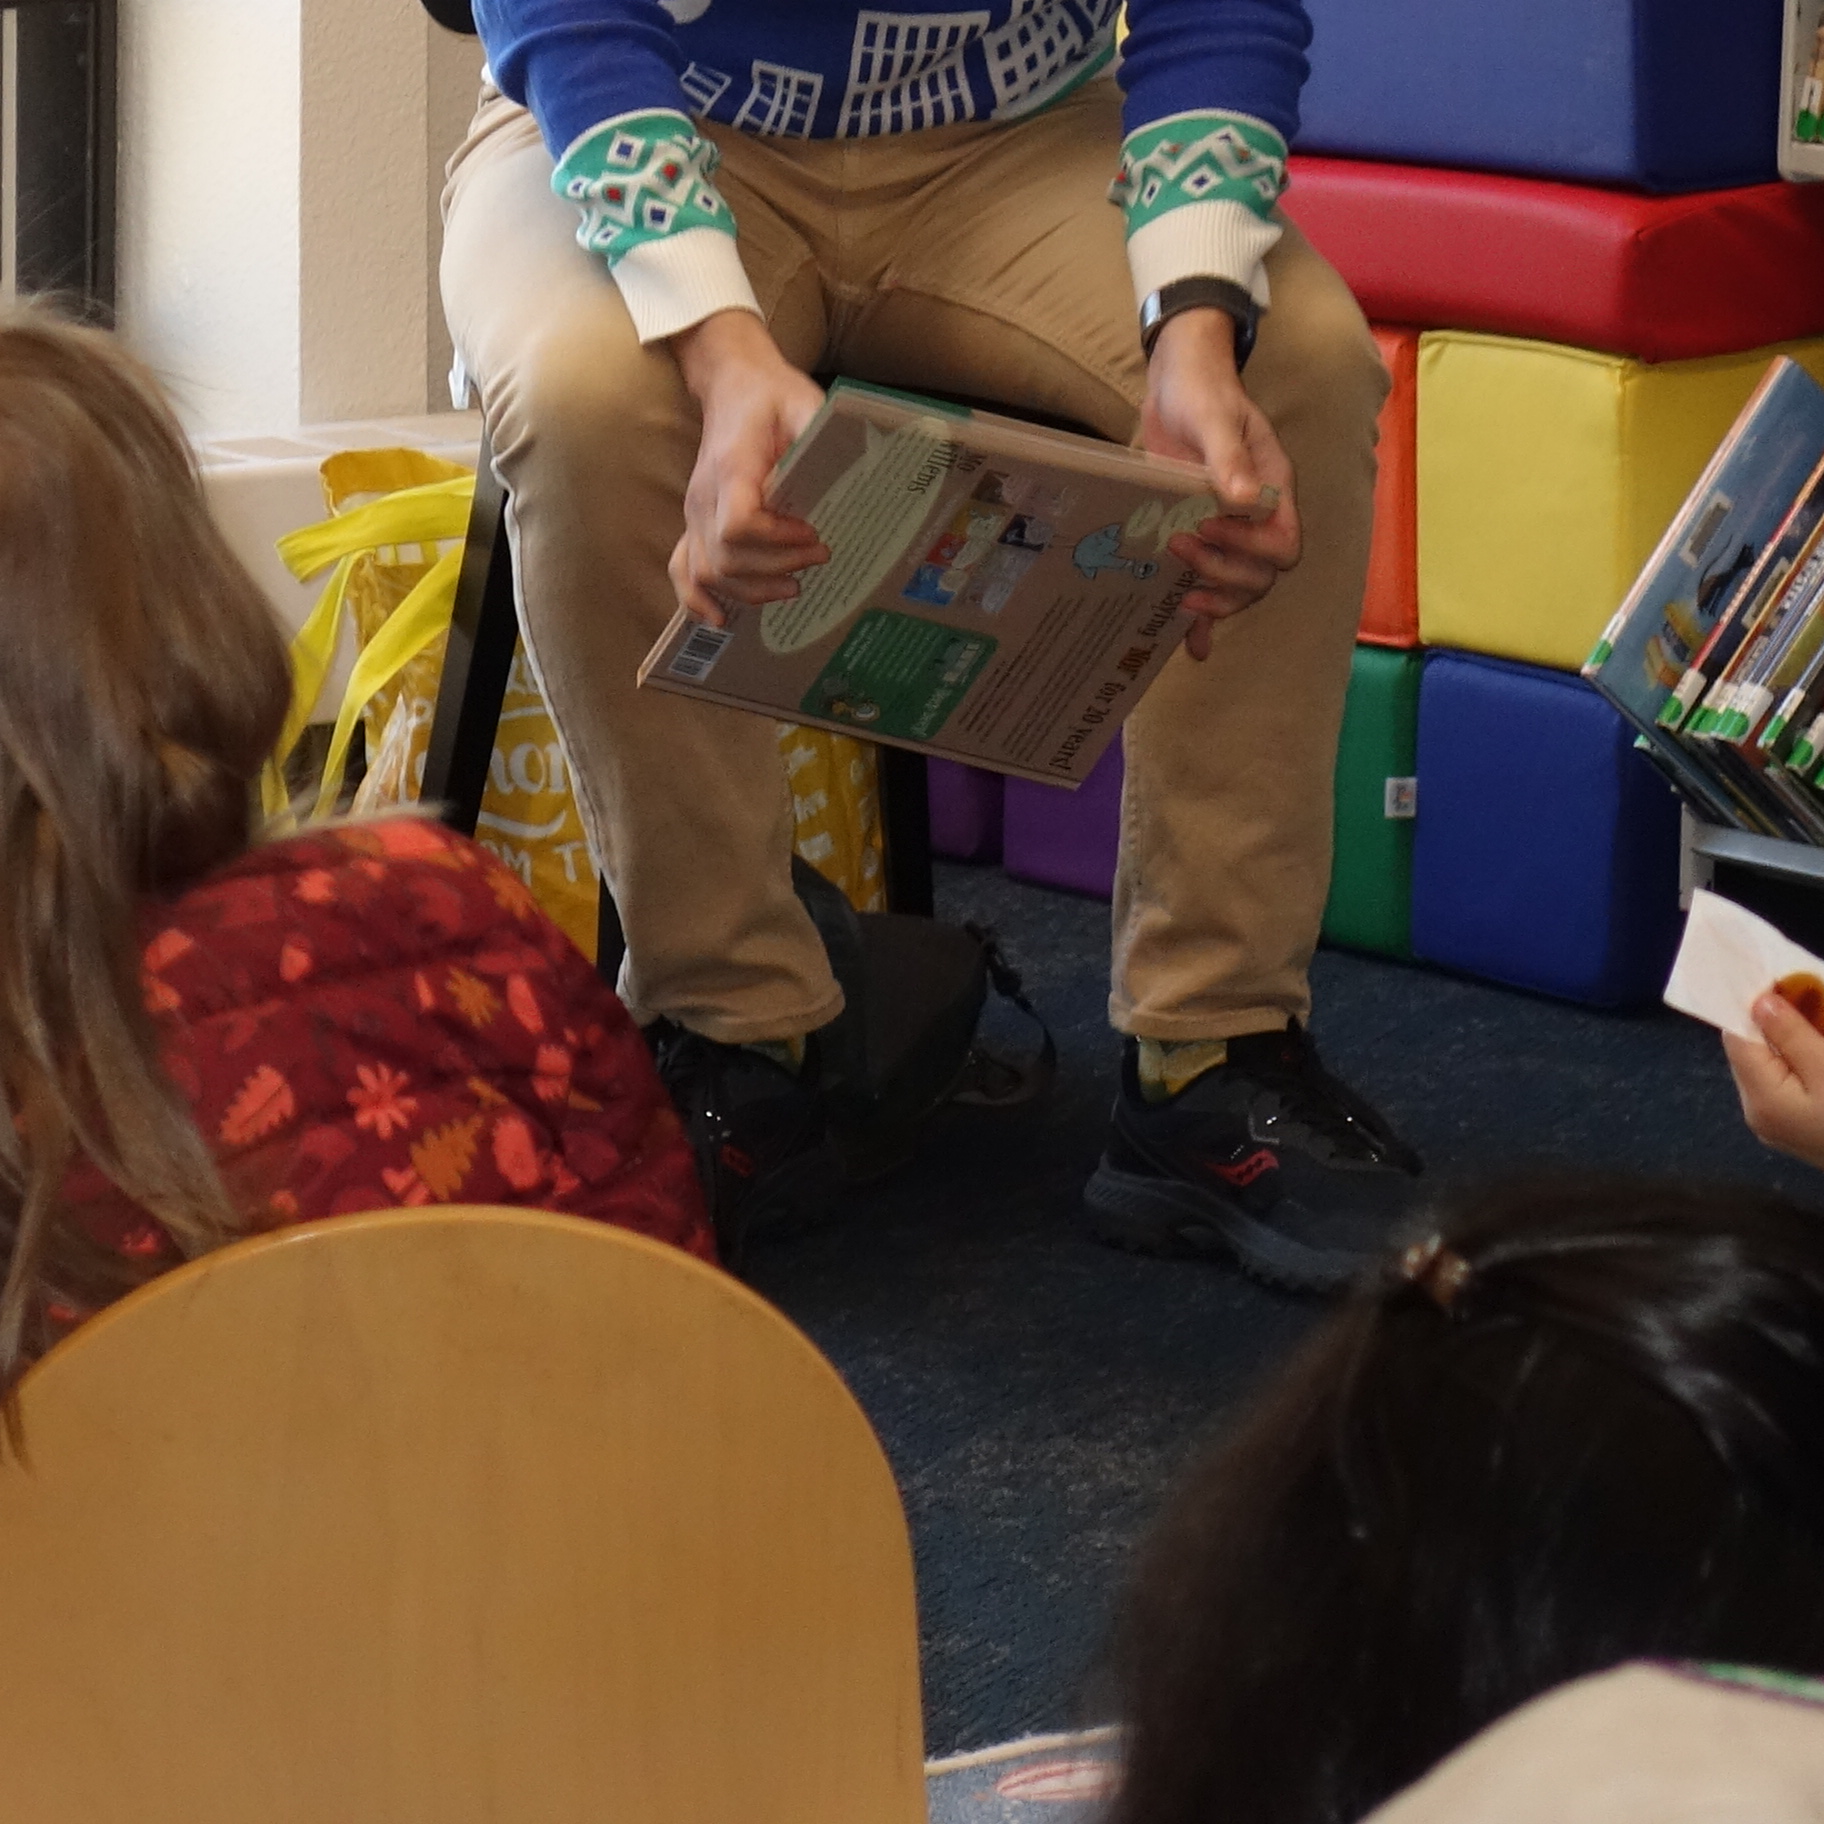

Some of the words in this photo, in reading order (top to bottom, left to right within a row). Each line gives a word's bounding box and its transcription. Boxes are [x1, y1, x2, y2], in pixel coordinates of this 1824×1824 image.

[1094, 680, 1127, 705] for
[1082, 705, 1111, 725] 20
[1048, 727, 1093, 771] years!
